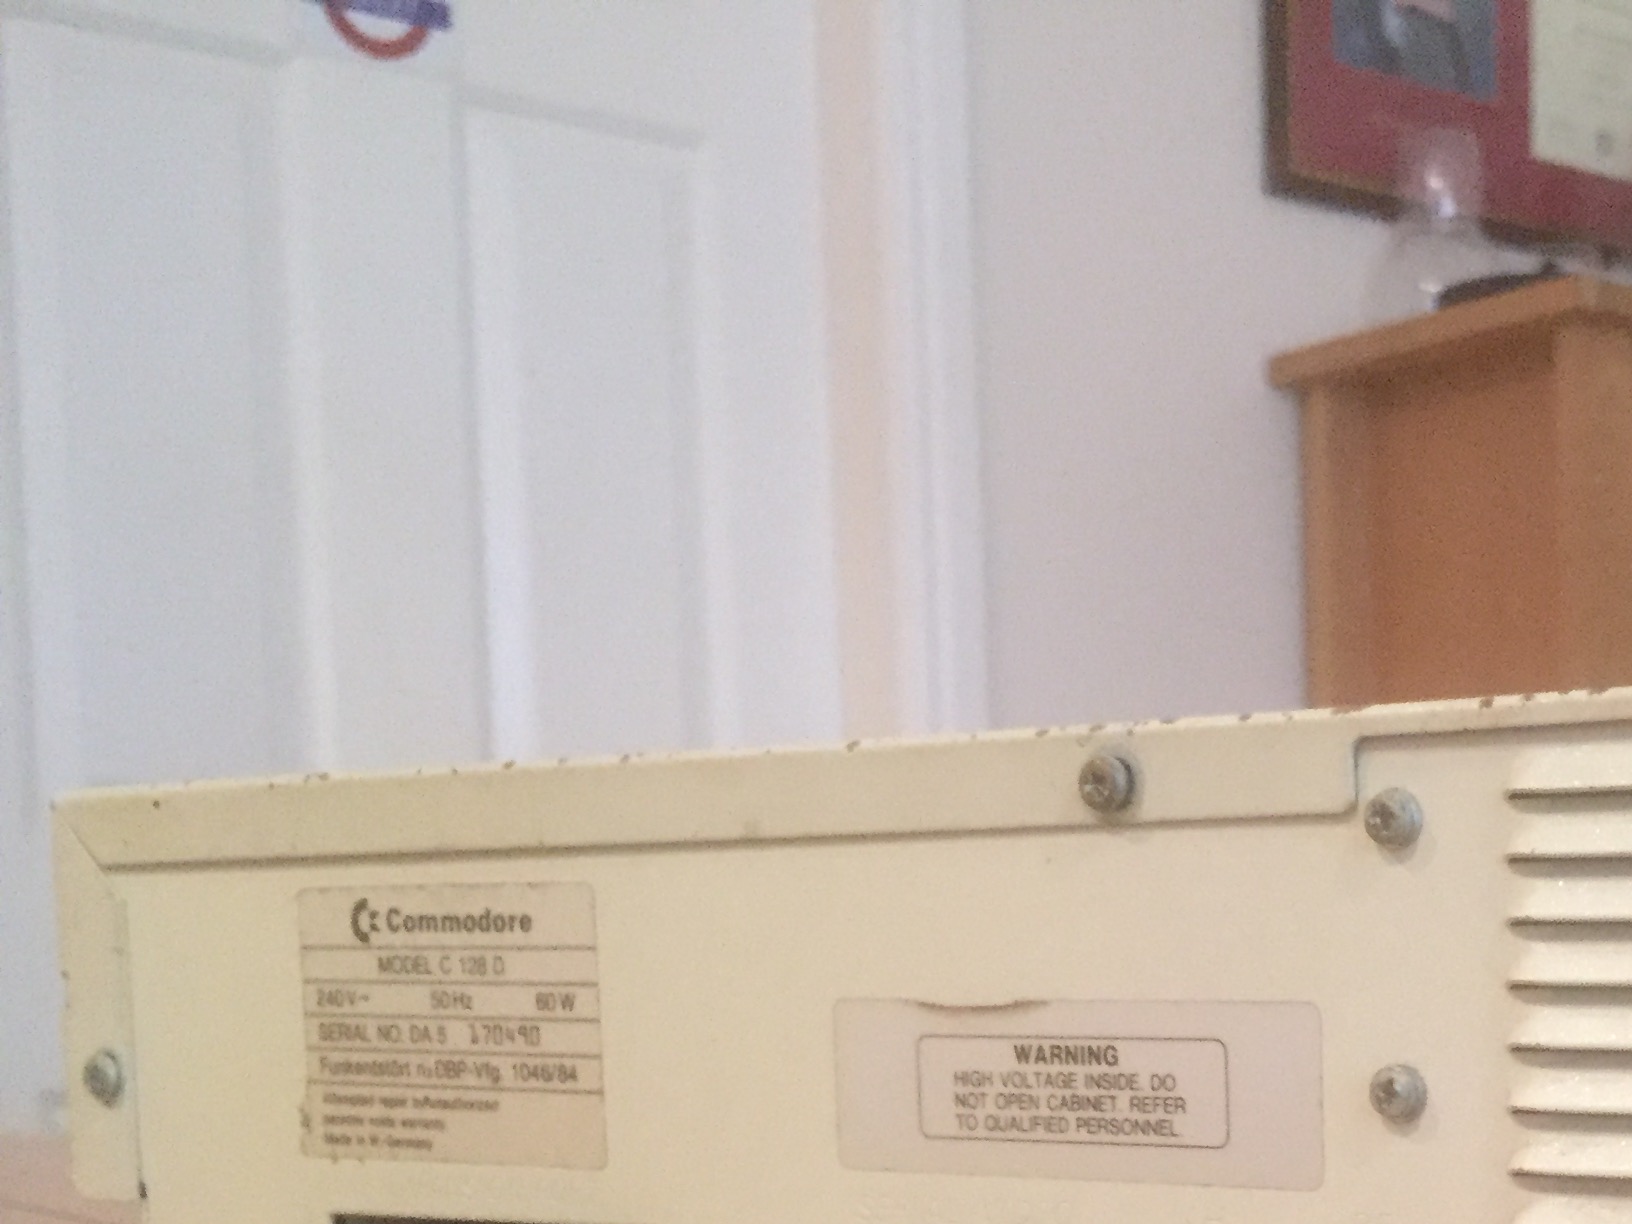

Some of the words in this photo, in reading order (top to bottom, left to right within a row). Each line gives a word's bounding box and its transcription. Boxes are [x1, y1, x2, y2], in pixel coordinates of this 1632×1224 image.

[387, 907, 532, 933] Commodore
[377, 954, 433, 976] MODEL
[439, 954, 453, 975] C
[459, 955, 488, 977] 128
[318, 1021, 372, 1043] SERIAL
[1013, 1044, 1119, 1067] WARNING
[954, 1071, 993, 1088] HIGH
[1000, 1072, 1077, 1090] VOLTAGE
[1150, 1074, 1176, 1092] DO
[954, 1093, 987, 1110] NOT
[995, 1093, 1040, 1111] OPEN
[1129, 1096, 1187, 1114] REFER
[956, 1114, 978, 1132] TO
[984, 1115, 1069, 1134] QUALIFIED
